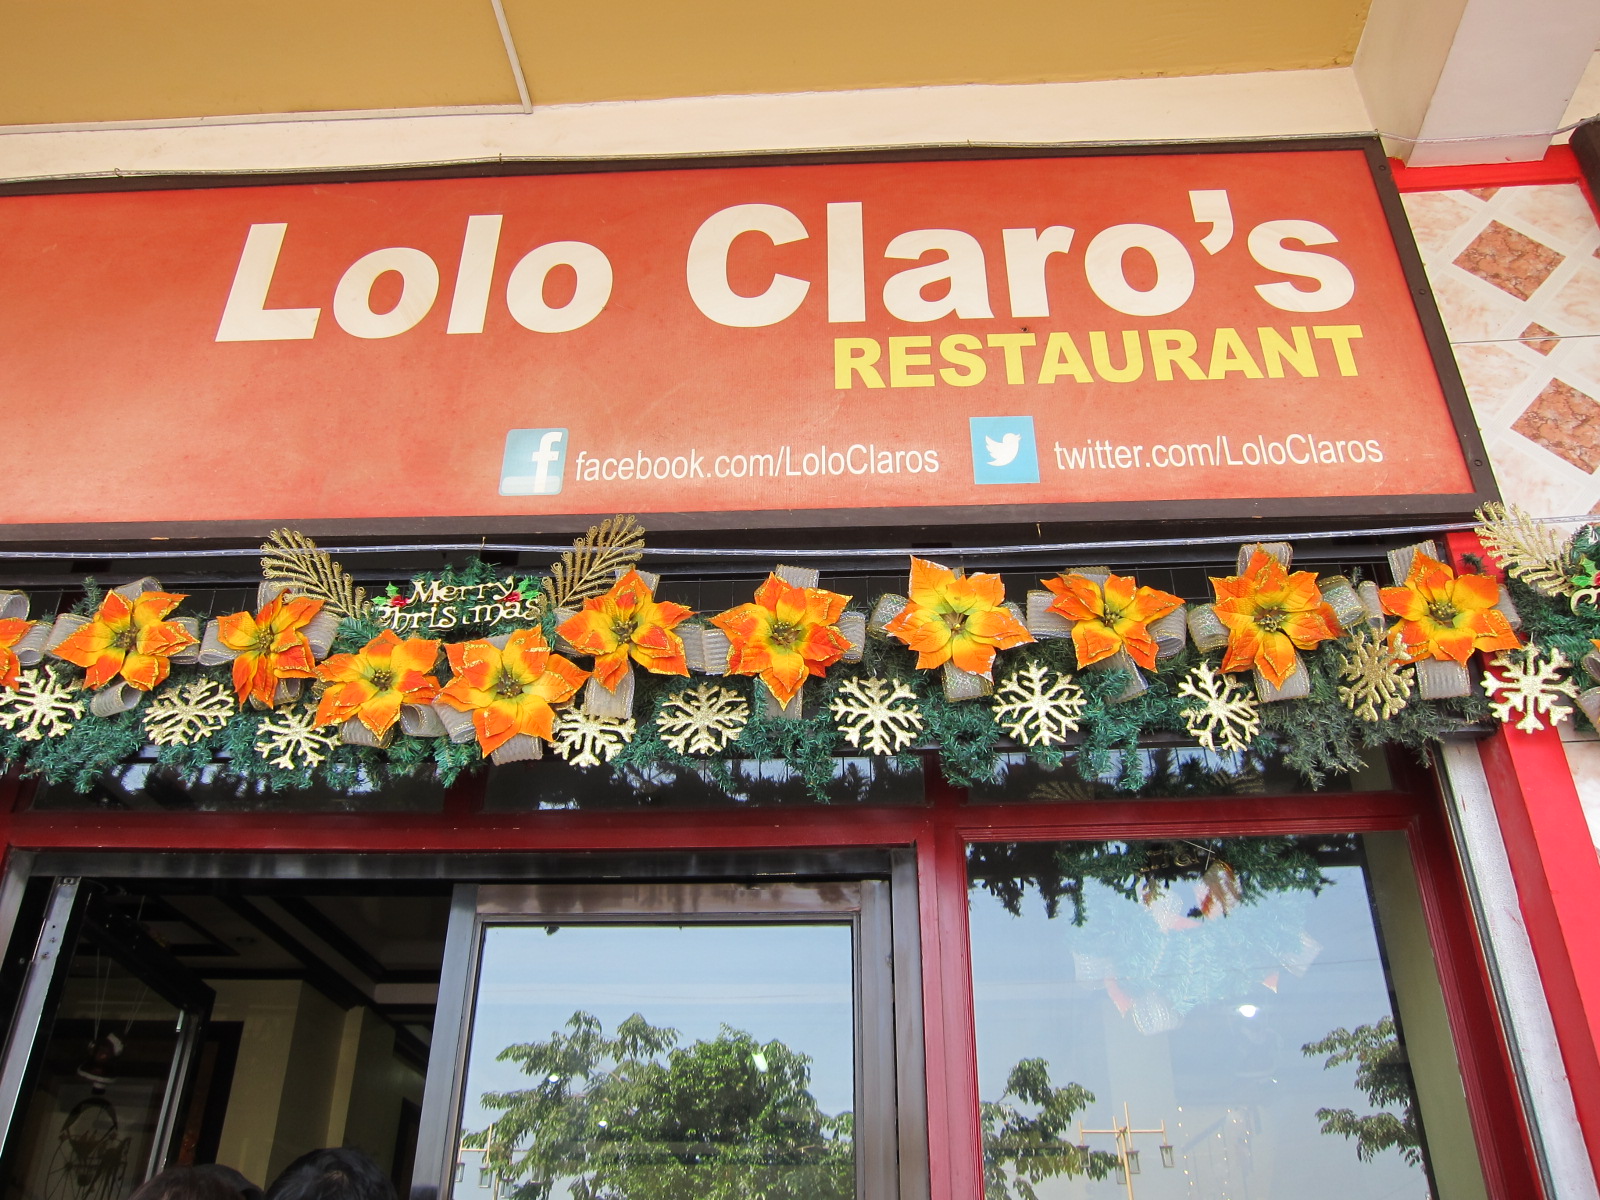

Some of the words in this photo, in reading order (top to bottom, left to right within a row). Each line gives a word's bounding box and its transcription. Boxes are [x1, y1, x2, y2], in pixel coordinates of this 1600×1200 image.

[215, 214, 613, 342] Lolo
[686, 190, 1355, 328] Claro's
[834, 325, 1363, 389] RESTAURANT
[575, 443, 940, 481] facebook.com/LoloClaros
[1053, 433, 1384, 470] twitter.com/LoloClaros
[406, 576, 514, 604] Merry
